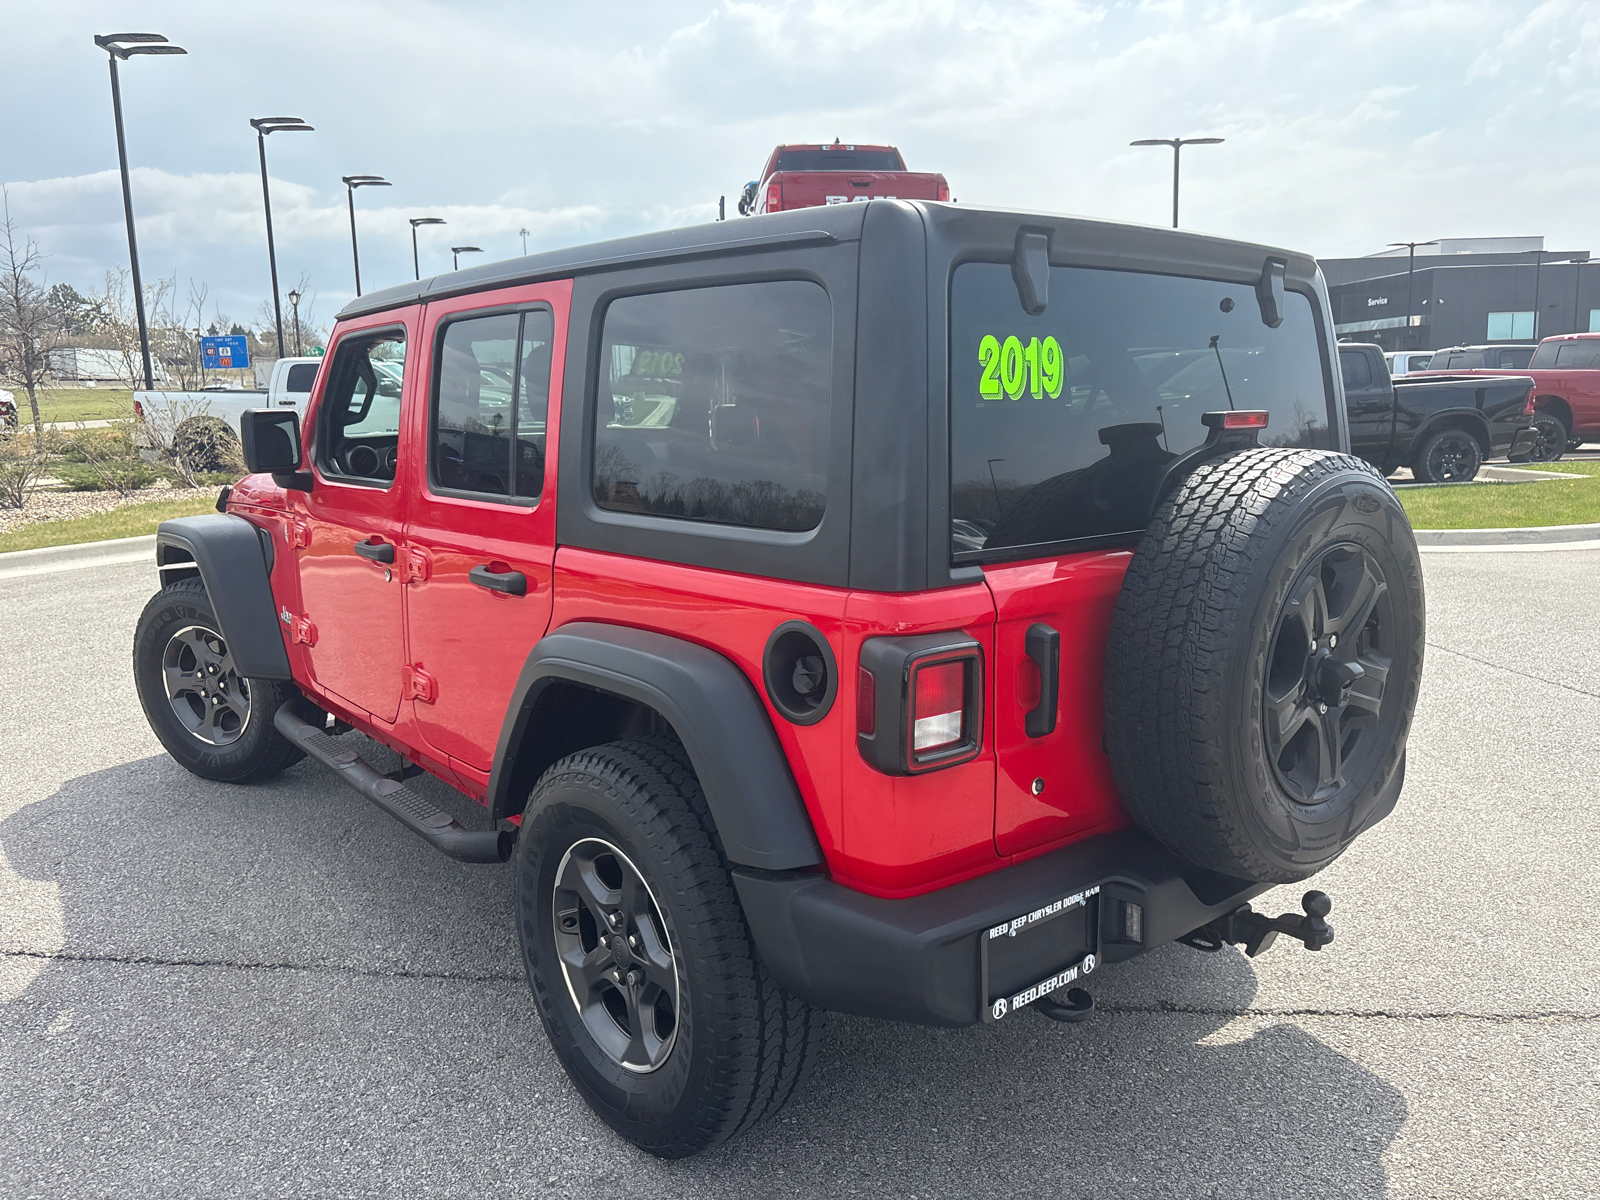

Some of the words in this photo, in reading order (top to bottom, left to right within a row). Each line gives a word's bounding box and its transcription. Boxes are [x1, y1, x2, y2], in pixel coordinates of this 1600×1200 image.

[1367, 297, 1388, 307] Service
[978, 334, 1064, 400] 2019
[989, 922, 1008, 939] REED
[1010, 915, 1027, 930] JEEP
[1027, 900, 1062, 923] CHRYSLER
[1062, 892, 1084, 908] DODGE
[1085, 885, 1100, 899] RAM
[1012, 966, 1078, 1011] REEDJEEP.COM
